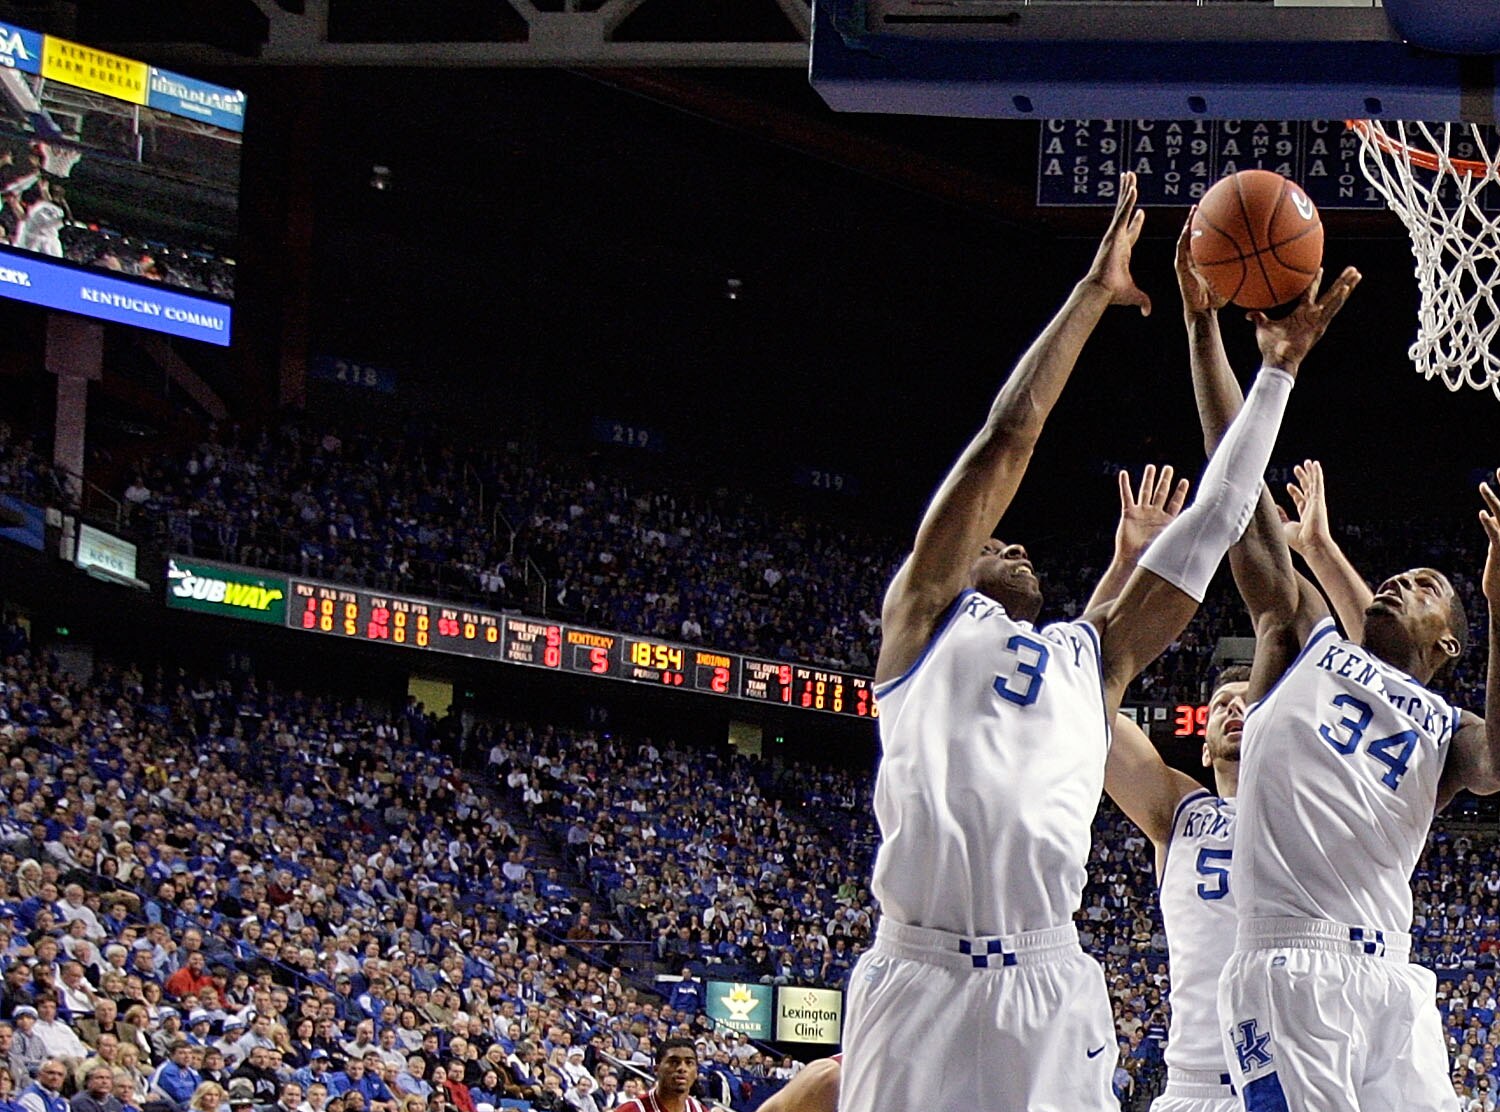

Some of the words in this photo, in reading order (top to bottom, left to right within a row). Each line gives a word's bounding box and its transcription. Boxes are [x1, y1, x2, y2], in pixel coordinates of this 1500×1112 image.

[48, 56, 84, 78] FARM
[61, 45, 132, 72] KENTUCKY
[1097, 119, 1117, 197] 1942
[1189, 119, 1208, 198] 1948
[1073, 156, 1090, 194] FOUR
[80, 286, 162, 317] KENTUCKY
[164, 307, 224, 331] COMMU
[173, 577, 284, 611] SUBWAY
[567, 631, 614, 649] KENTUCKY
[544, 646, 560, 667] 0
[590, 648, 609, 674] 5
[632, 642, 682, 670] 18:54
[633, 668, 659, 681] PERIOD
[711, 667, 730, 693] 2
[992, 634, 1051, 707] 3
[1316, 645, 1453, 747] KENUCKY
[1318, 693, 1420, 792] 34
[1196, 848, 1233, 901] 5
[782, 1005, 838, 1024] Lexington
[794, 1022, 824, 1038] Clinic
